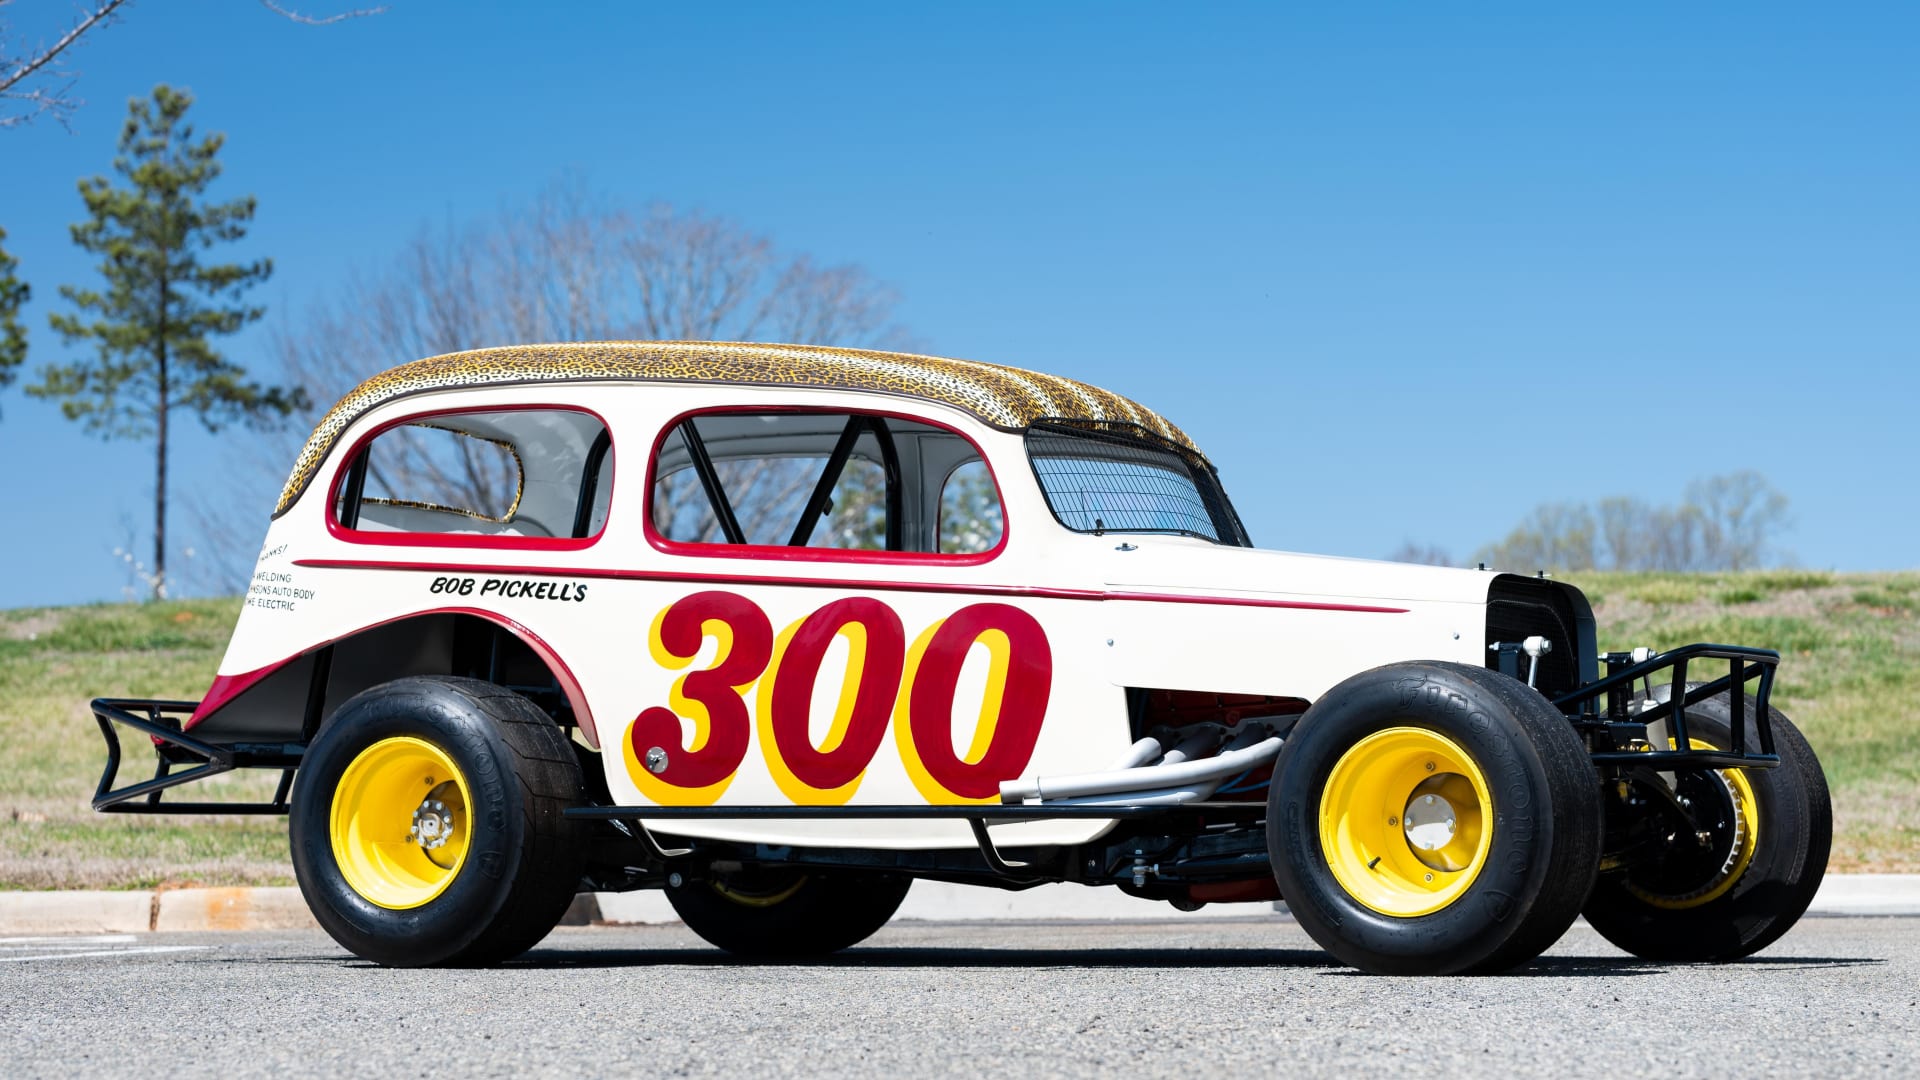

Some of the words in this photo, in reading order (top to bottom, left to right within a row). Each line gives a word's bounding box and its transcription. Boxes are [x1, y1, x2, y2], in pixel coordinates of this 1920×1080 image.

[256, 571, 292, 583] WELDING
[272, 586, 292, 597] AUTO
[293, 588, 315, 600] BODY
[430, 577, 475, 596] BOB
[480, 578, 588, 602] PICKELL'S
[258, 598, 295, 611] ELECTRIC
[622, 590, 1052, 805] 300
[1390, 674, 1532, 875] Firestone
